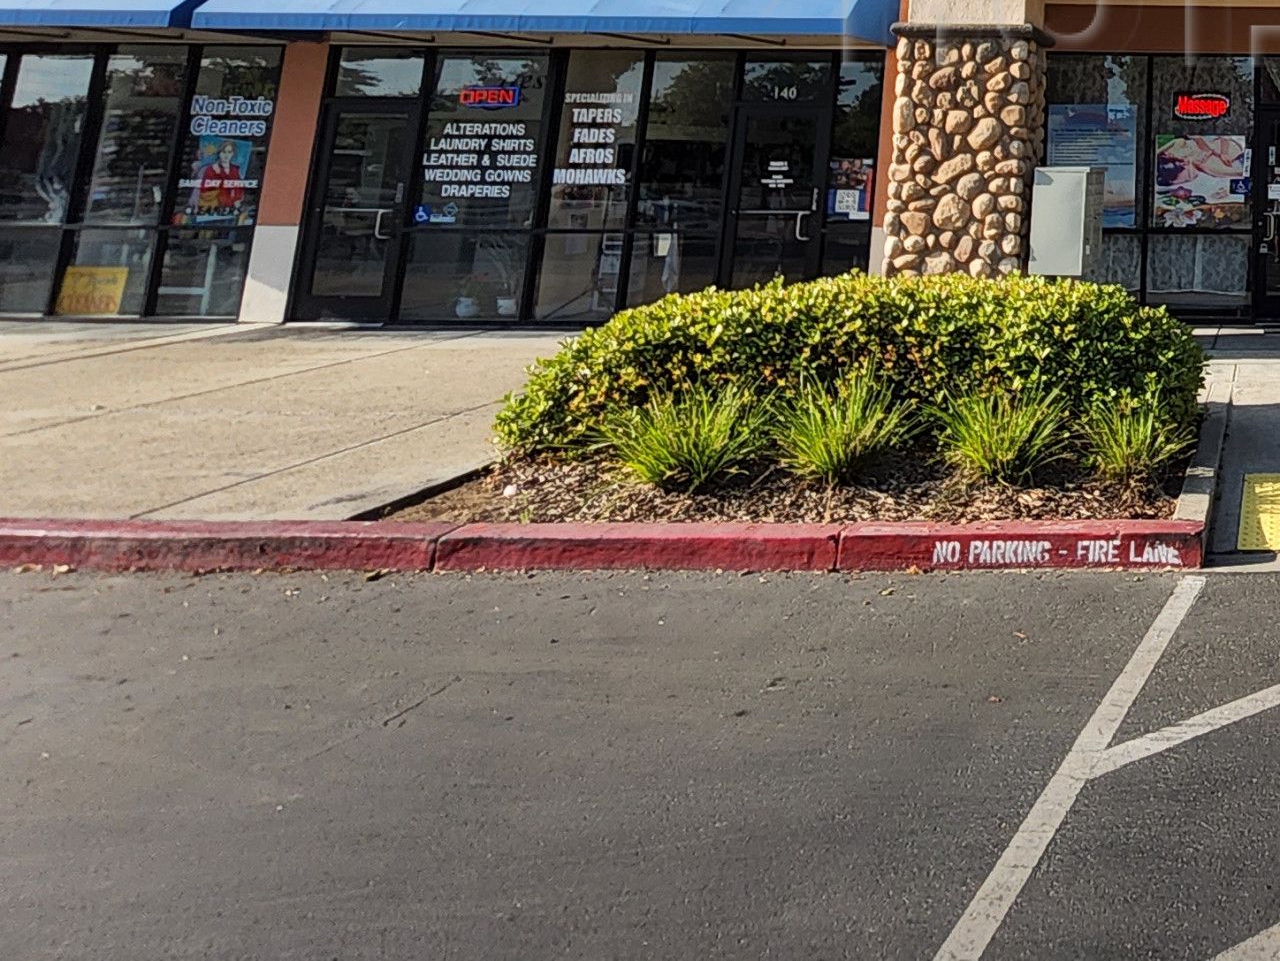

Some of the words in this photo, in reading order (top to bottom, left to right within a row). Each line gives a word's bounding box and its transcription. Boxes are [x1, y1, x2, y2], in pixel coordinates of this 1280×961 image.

[459, 87, 514, 104] OPEN
[774, 85, 798, 99] 140
[190, 95, 274, 116] Non-Toxic
[1177, 95, 1228, 117] Massage
[572, 108, 622, 123] TAPERS
[190, 116, 267, 136] Cleaners
[443, 123, 526, 136] ALTERATIONS
[573, 128, 616, 143] FADES
[430, 138, 487, 151] LAUNDRY
[490, 139, 535, 152] SHIRTS
[422, 153, 478, 166] LEATHER
[481, 154, 491, 167] &
[496, 154, 538, 167] SUEDE
[569, 148, 614, 164] AFROS
[424, 168, 482, 182] WEDDING
[485, 169, 532, 182] GOWNS
[553, 168, 626, 185] MOHAWKS
[223, 179, 259, 189] SERVICE
[441, 184, 511, 198] DRAPERIES
[933, 540, 961, 564] NO
[968, 540, 1052, 564] PARKING
[1076, 539, 1121, 564] FIRE
